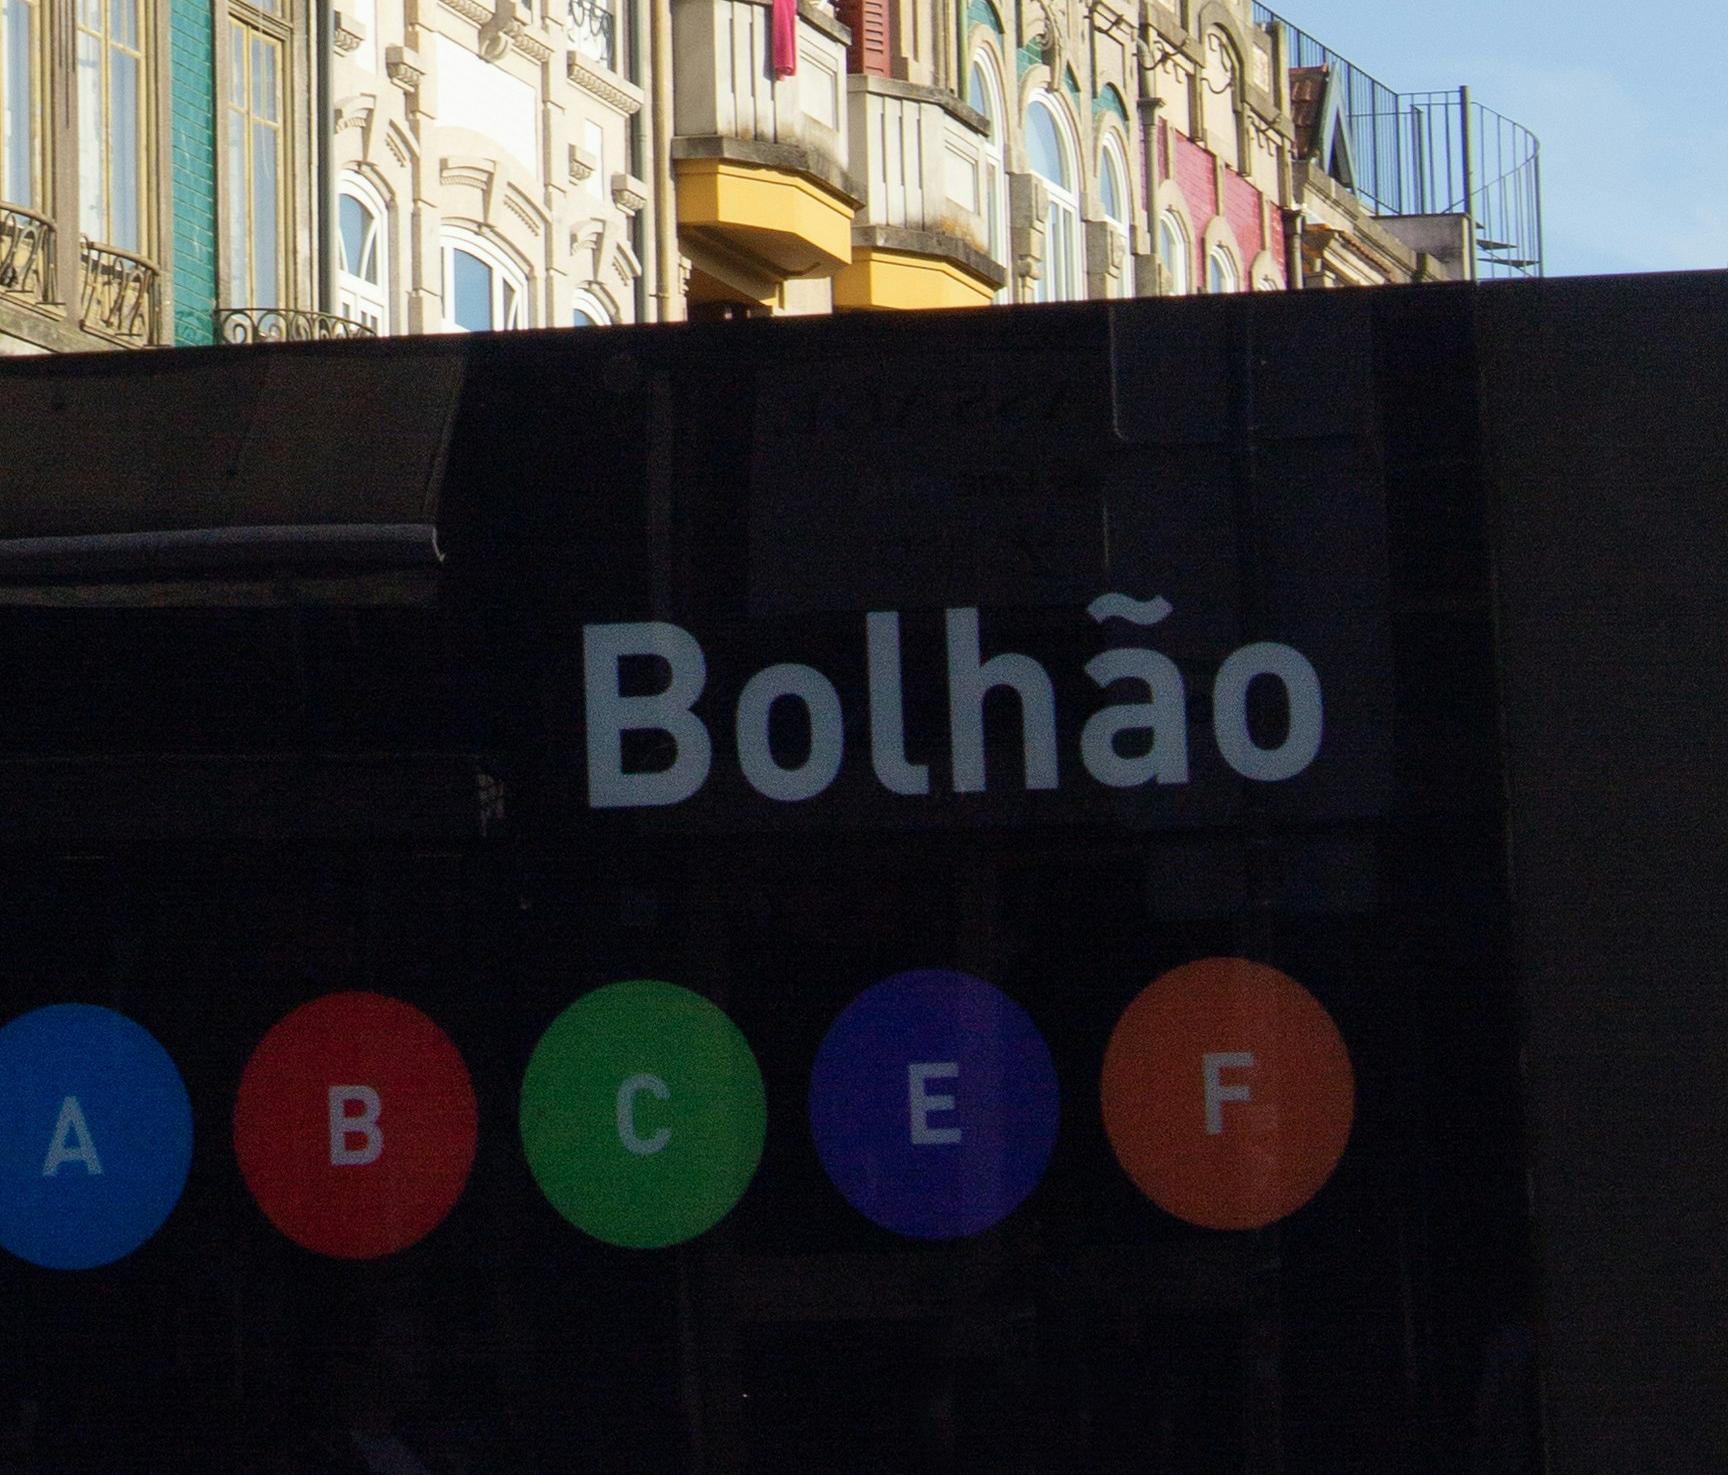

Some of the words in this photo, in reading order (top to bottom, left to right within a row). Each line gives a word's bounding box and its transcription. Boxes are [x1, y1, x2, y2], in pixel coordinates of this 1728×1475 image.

[583, 593, 1324, 808] Bolhão
[42, 1095, 103, 1177] A
[327, 1084, 384, 1166] B
[615, 1073, 672, 1156] C
[906, 1061, 963, 1145] E
[1201, 1051, 1256, 1135] F
